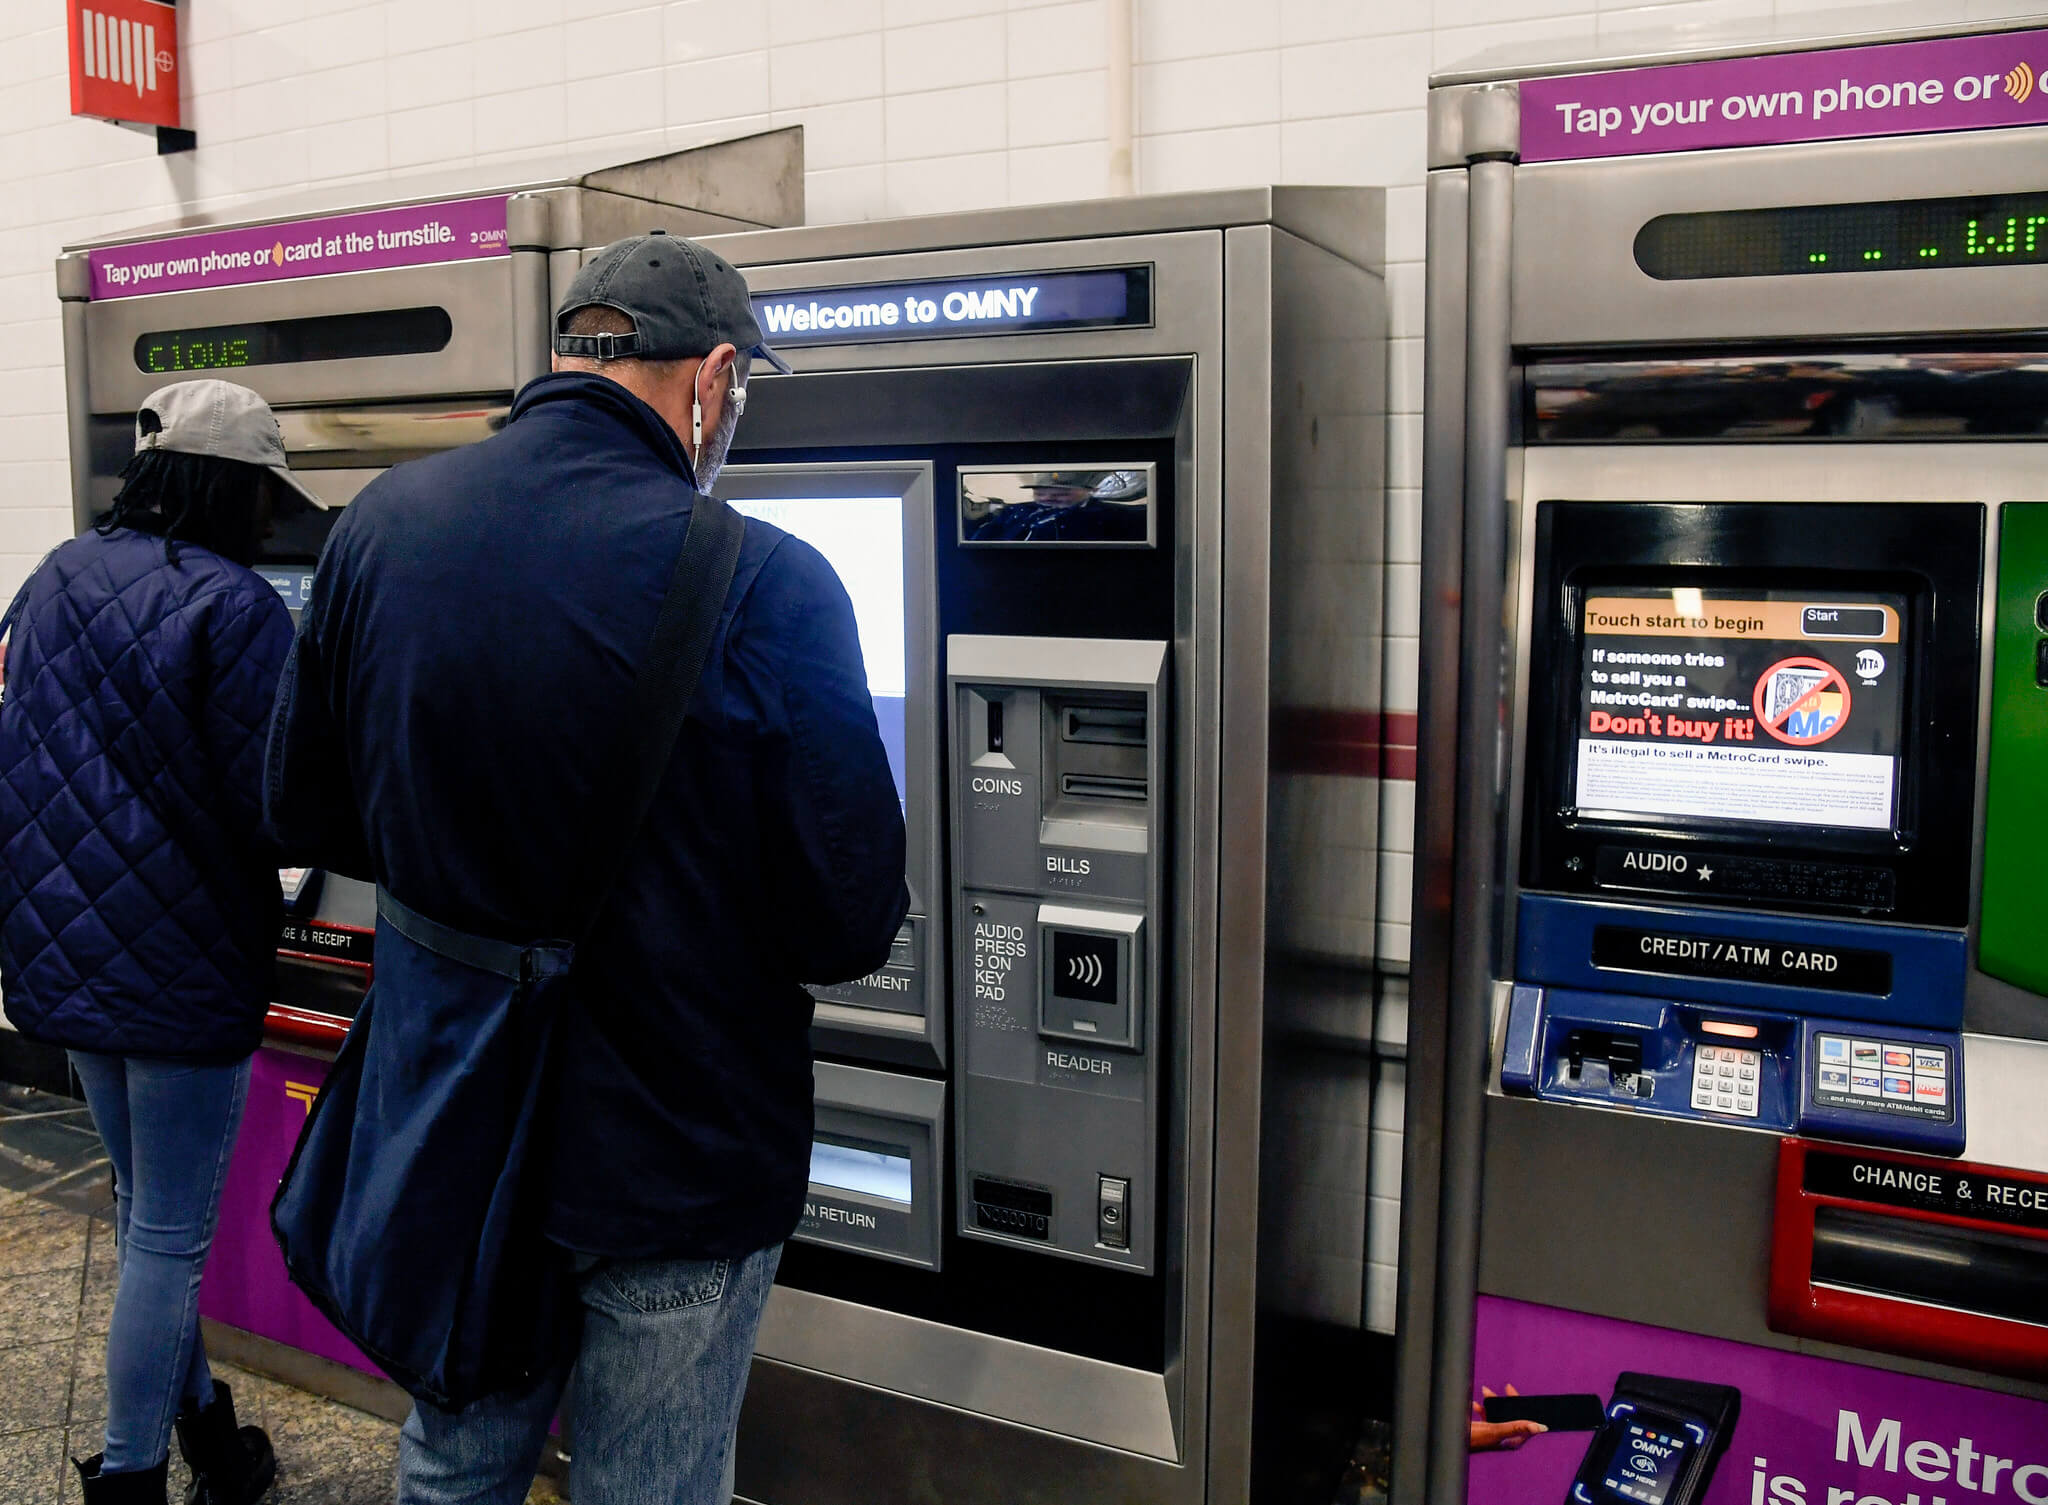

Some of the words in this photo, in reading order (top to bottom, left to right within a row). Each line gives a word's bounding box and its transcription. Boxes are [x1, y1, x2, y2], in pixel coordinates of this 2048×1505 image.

[1556, 102, 1622, 137] Tap
[1630, 98, 1713, 134] your
[1721, 90, 1803, 120] own
[1813, 79, 1944, 120] phone
[1953, 74, 2000, 101] or
[103, 264, 130, 286] Tap
[131, 261, 165, 284] your
[166, 259, 199, 276] own
[201, 250, 251, 276] phone
[253, 248, 272, 266] or
[284, 237, 322, 262] card
[325, 235, 342, 257] at
[344, 232, 374, 254] the
[377, 222, 456, 250] turnstile.
[763, 301, 900, 333] Welcome
[904, 296, 937, 324] to
[942, 286, 1039, 321] OMNY
[1586, 611, 1640, 629] Touch
[1645, 613, 1686, 629] start
[1691, 615, 1709, 630] to
[1713, 615, 1764, 634] begin
[1807, 609, 1839, 622] Start
[1592, 649, 1606, 663] If
[1607, 651, 1682, 666] someone
[1685, 652, 1725, 667] tries
[1856, 657, 1879, 671] MTA
[1591, 670, 1609, 684] to
[1611, 671, 1641, 685] sell
[1643, 674, 1672, 687] you
[1675, 675, 1686, 687] a
[1589, 708, 1662, 736] Don't
[1667, 714, 1720, 743] buy
[1724, 716, 1755, 741] it!
[1588, 744, 1608, 754] It's
[1611, 745, 1650, 758] illegal
[1653, 748, 1666, 758] to
[1669, 749, 1693, 759] sell
[1696, 752, 1704, 760] a
[1707, 751, 1781, 764] MetroCard
[1784, 755, 1829, 768] swipe.
[972, 777, 1022, 796] COINS
[1046, 856, 1091, 875] BILLS
[1623, 851, 1688, 873] AUDIO
[282, 926, 296, 940] GE
[300, 929, 308, 941] &
[311, 930, 353, 948] RECEIPT
[974, 922, 1024, 941] AUDIO
[975, 938, 1027, 957] PRESS
[1640, 936, 1770, 966] CREDIT/ATM
[1781, 949, 1839, 972] CARD
[974, 954, 984, 968] 5
[988, 955, 1011, 971] ON
[975, 969, 1005, 985] KEY
[975, 984, 1005, 1001] PAD
[1047, 1051, 1112, 1075] READER
[1919, 1059, 1941, 1068] VISA
[1830, 1095, 1844, 1103] and
[1845, 1097, 1865, 1107] many
[1866, 1100, 1886, 1108] more
[1886, 1102, 1923, 1114] ATM/debit
[1924, 1108, 1946, 1116] cards
[1852, 1164, 1943, 1195] CHANGE
[1956, 1179, 1973, 1200] &
[819, 1206, 876, 1230] RETURN
[1631, 1439, 1673, 1459] OMNY
[1621, 1468, 1636, 1479] TAP
[1635, 1475, 1658, 1488] HERE
